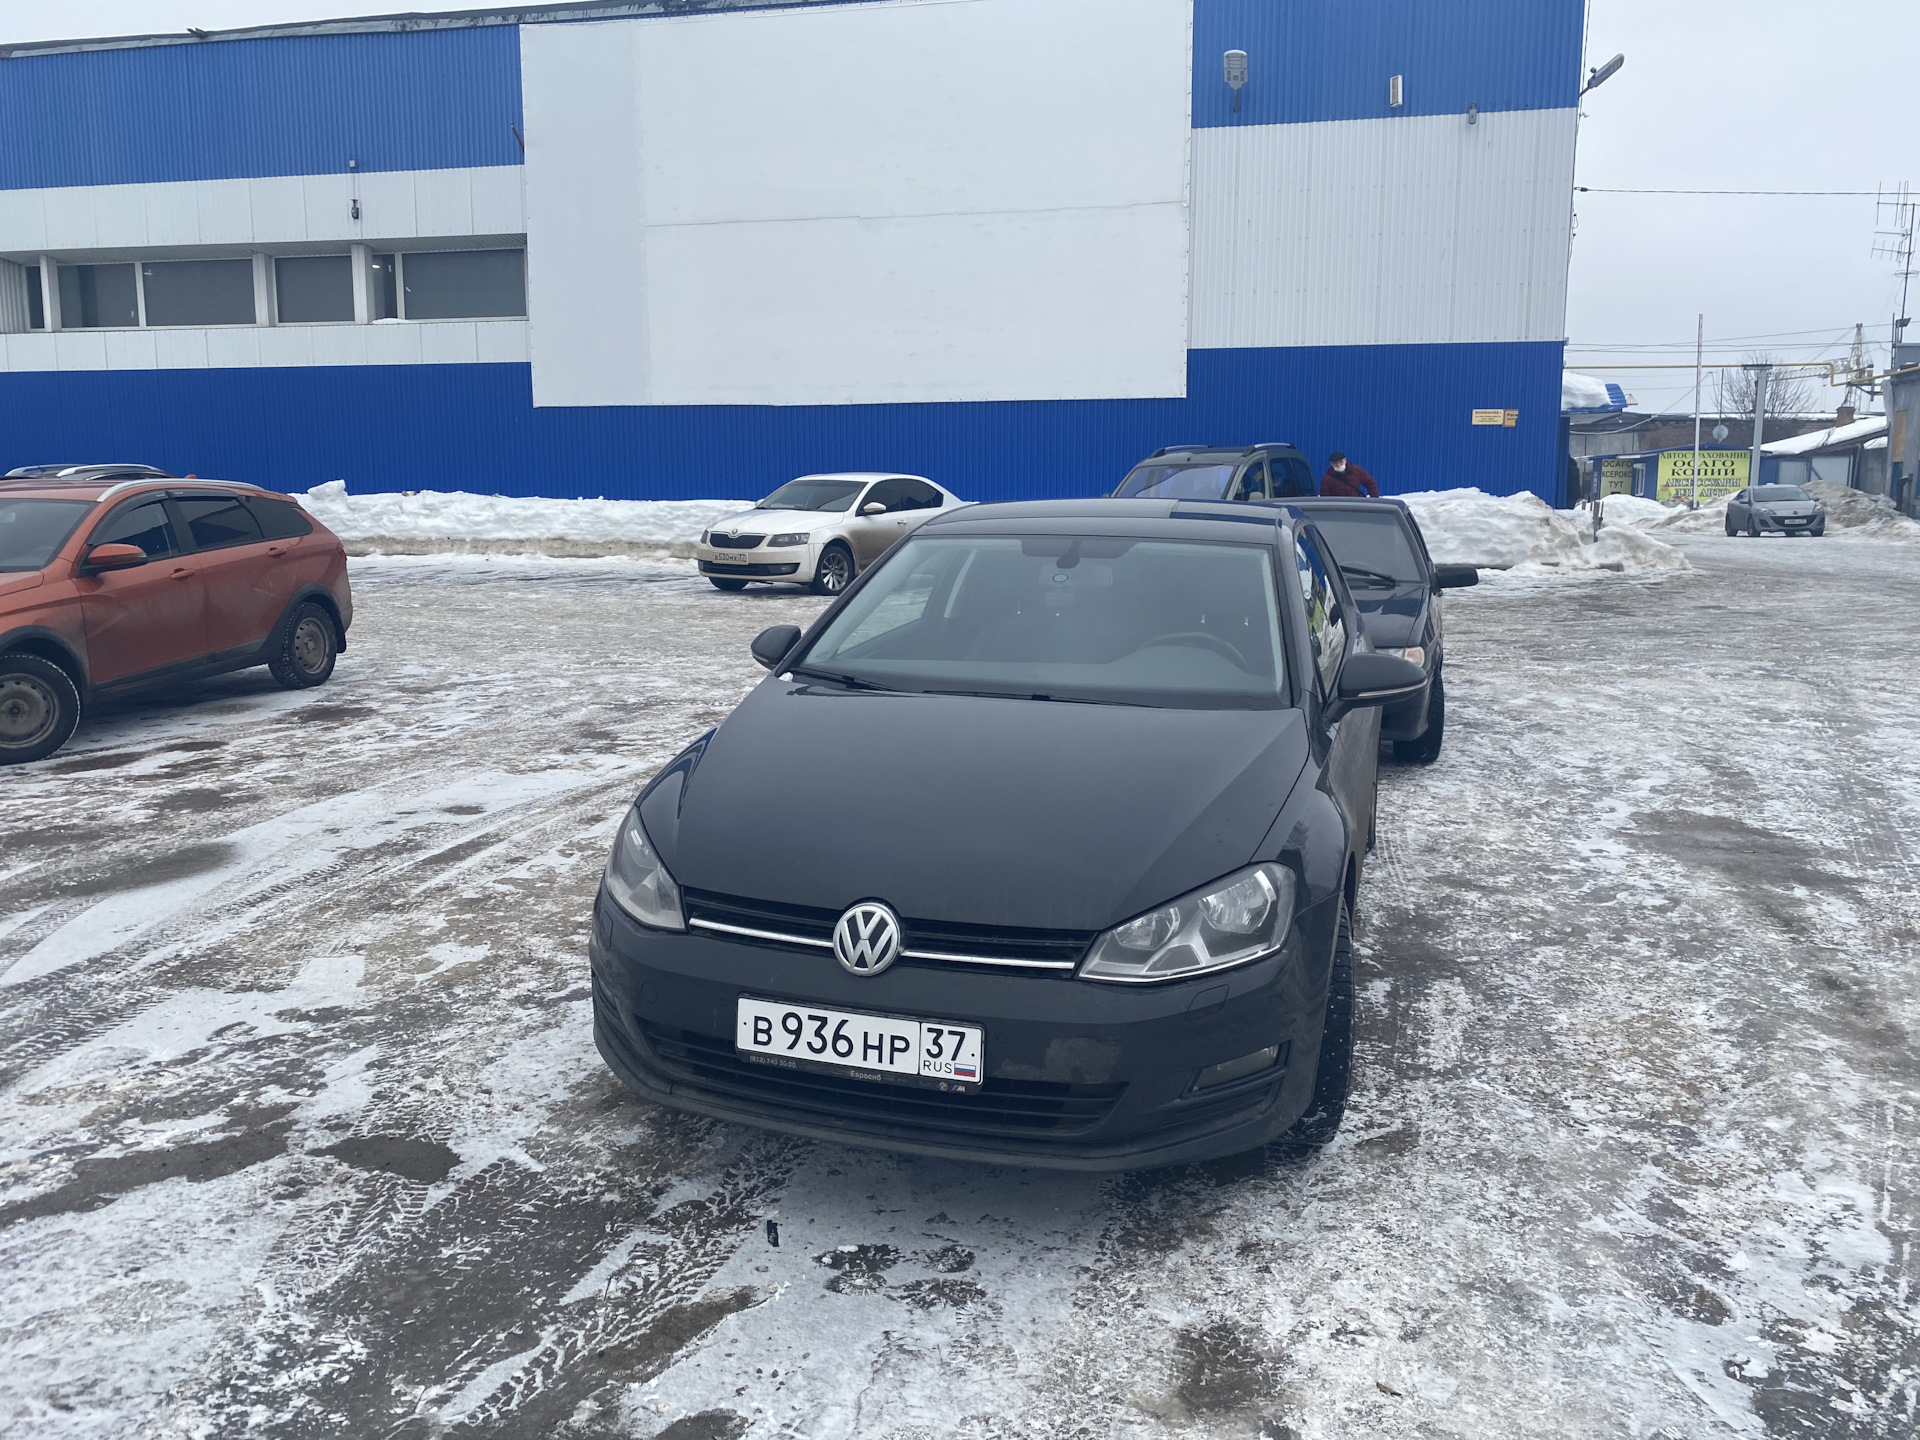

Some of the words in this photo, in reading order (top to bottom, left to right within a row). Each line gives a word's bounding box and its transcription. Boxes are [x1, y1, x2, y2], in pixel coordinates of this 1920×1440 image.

[1673, 459, 1735, 467] ОСАГО
[1601, 470, 1633, 478] КСЕРОКС
[1671, 468, 1736, 476] КОПИИ
[1608, 480, 1625, 488] ТУТ
[1664, 478, 1741, 487] АКСЕССУАРЫ
[925, 1027, 966, 1061] 37
[923, 1060, 952, 1074] RUS
[850, 1070, 882, 1081] Евросиб
